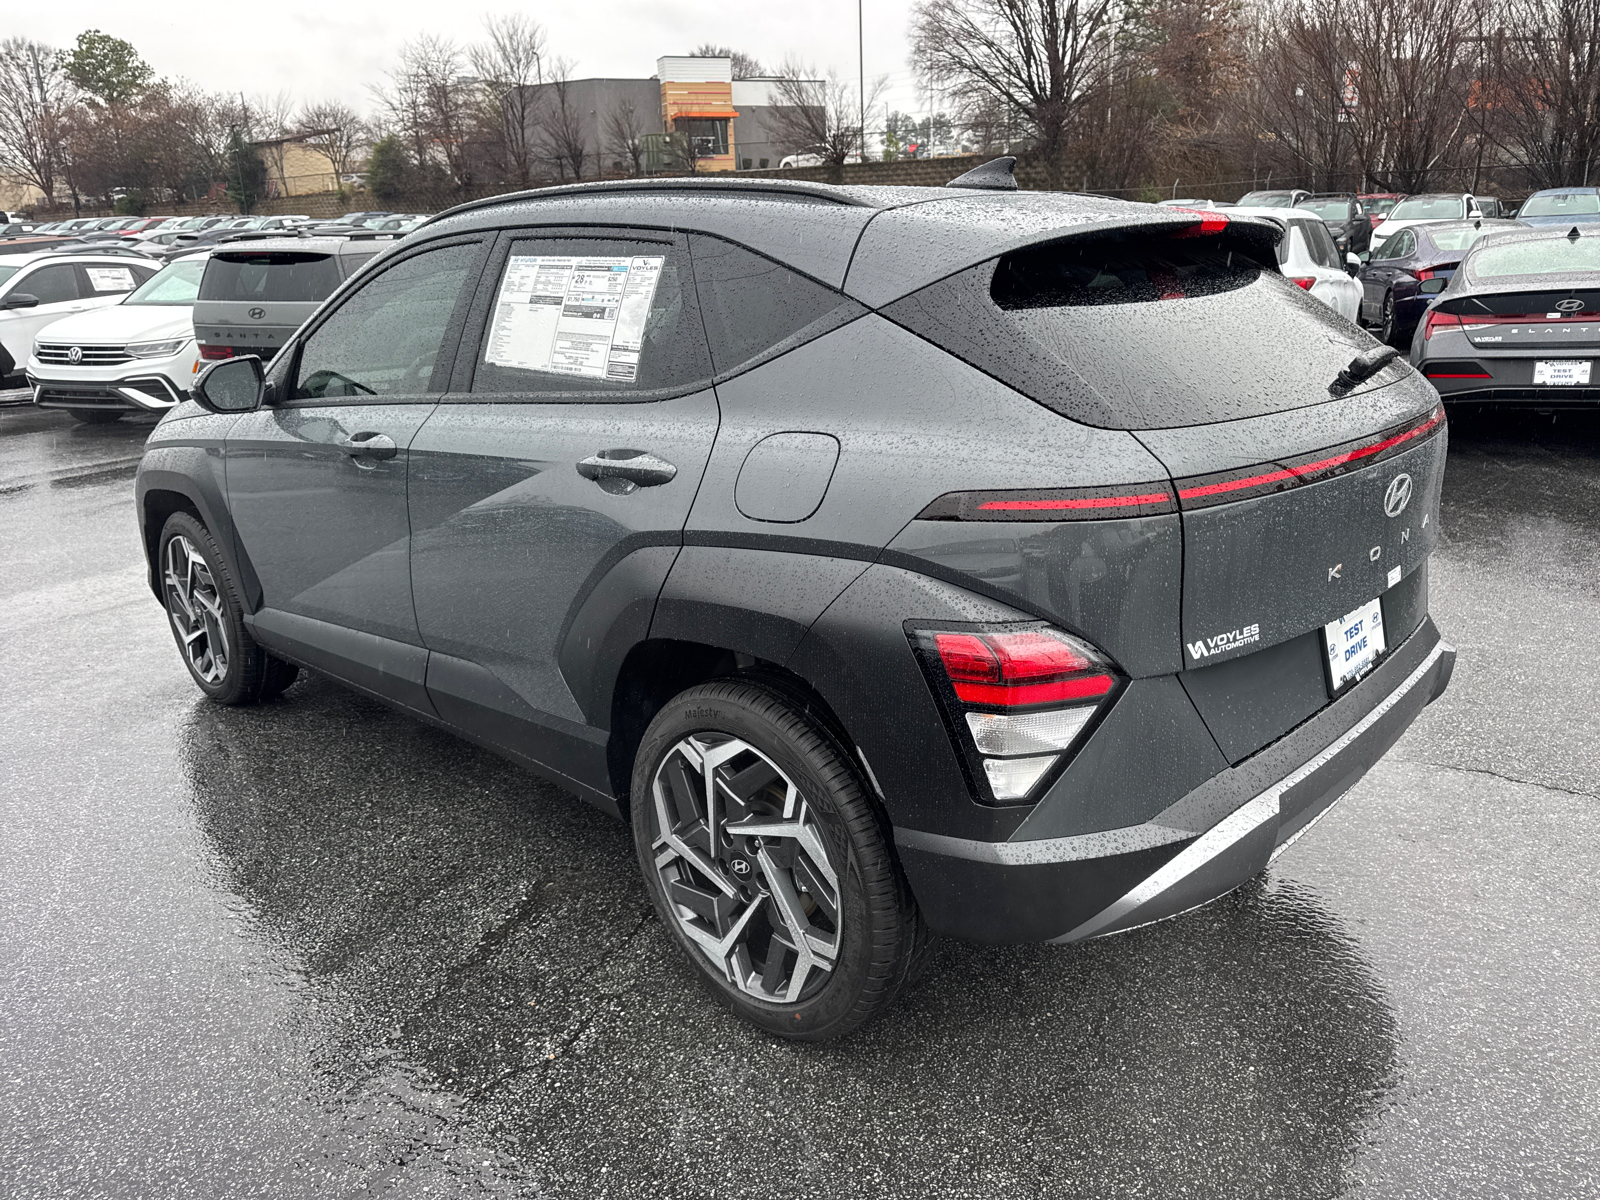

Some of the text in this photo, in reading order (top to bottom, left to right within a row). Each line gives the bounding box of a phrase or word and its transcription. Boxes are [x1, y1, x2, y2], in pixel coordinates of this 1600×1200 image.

[574, 274, 585, 284] 28
[1327, 512, 1430, 583] KONA
[1206, 623, 1260, 648] VOYLES
[1343, 619, 1364, 643] TEST
[1209, 633, 1260, 656] AUTOMOTIVE
[1344, 635, 1368, 662] DRIVE
